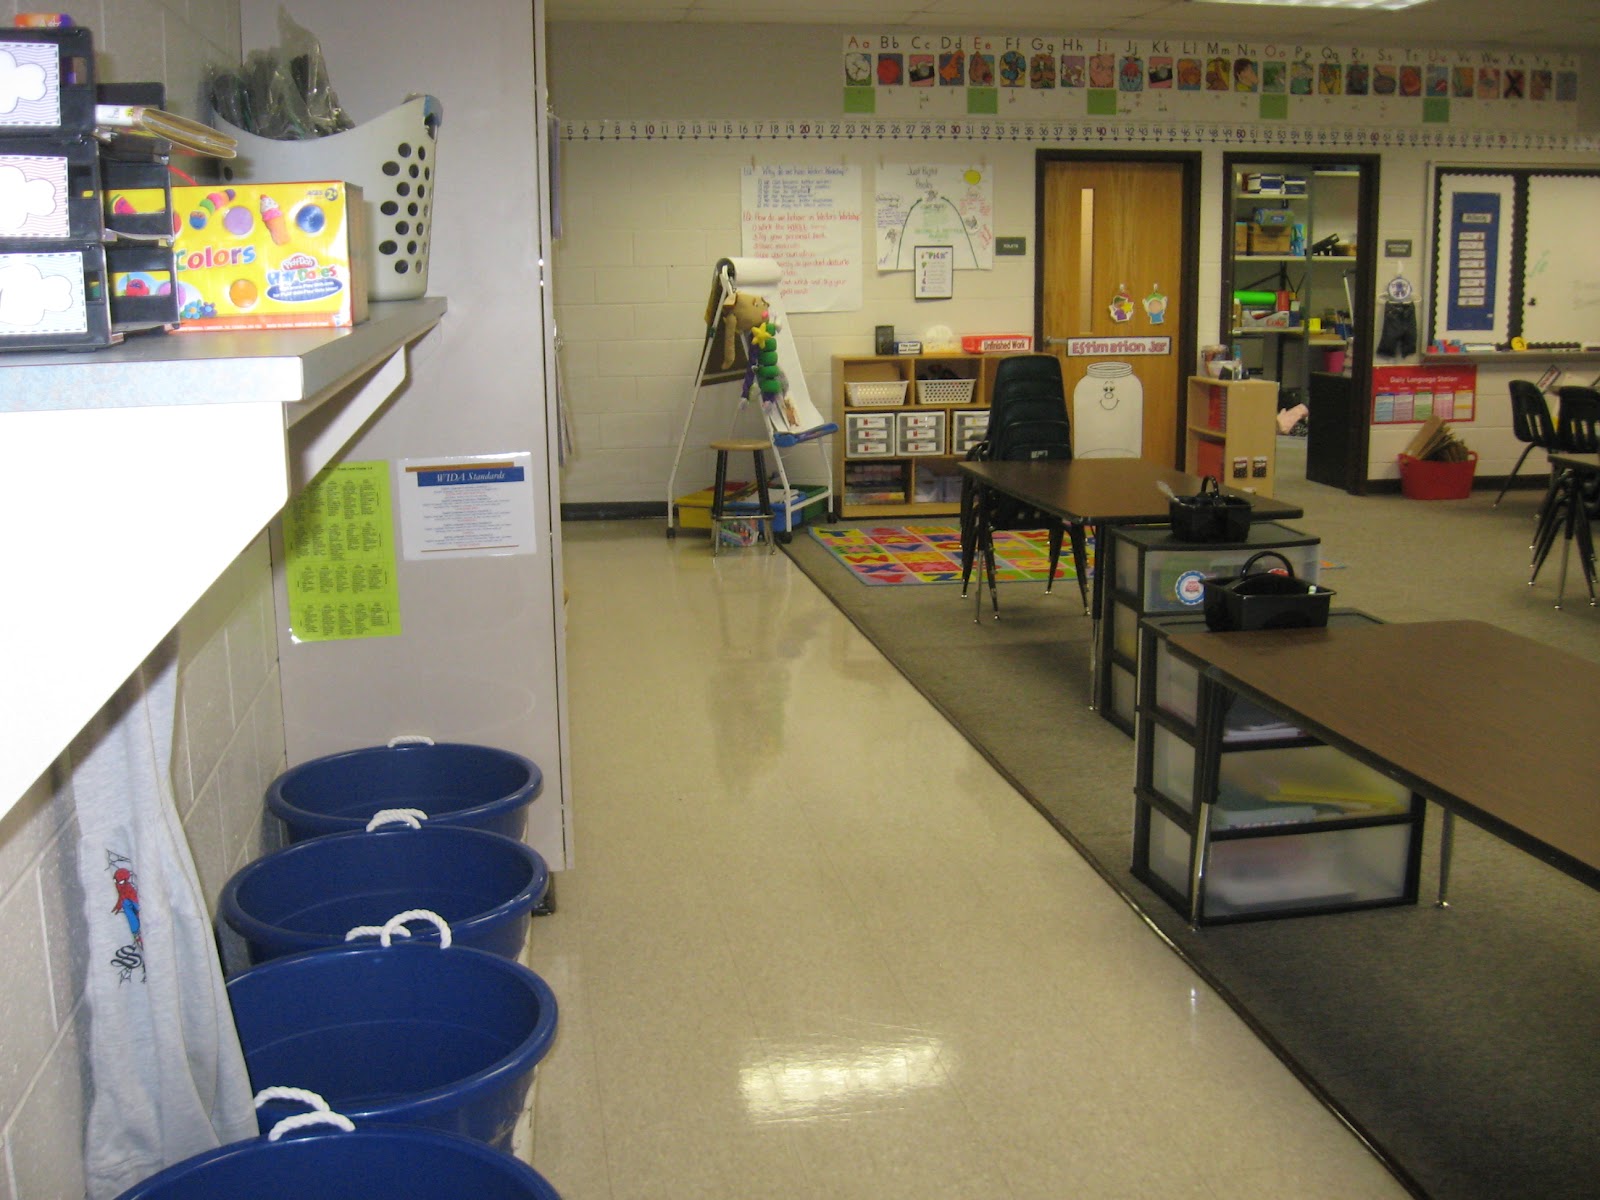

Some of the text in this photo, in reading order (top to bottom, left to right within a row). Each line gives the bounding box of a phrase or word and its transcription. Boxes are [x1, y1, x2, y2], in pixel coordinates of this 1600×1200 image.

[1012, 340, 1025, 349] Work
[1072, 341, 1146, 355] Estimation
[437, 470, 505, 482] WIDA Standards
